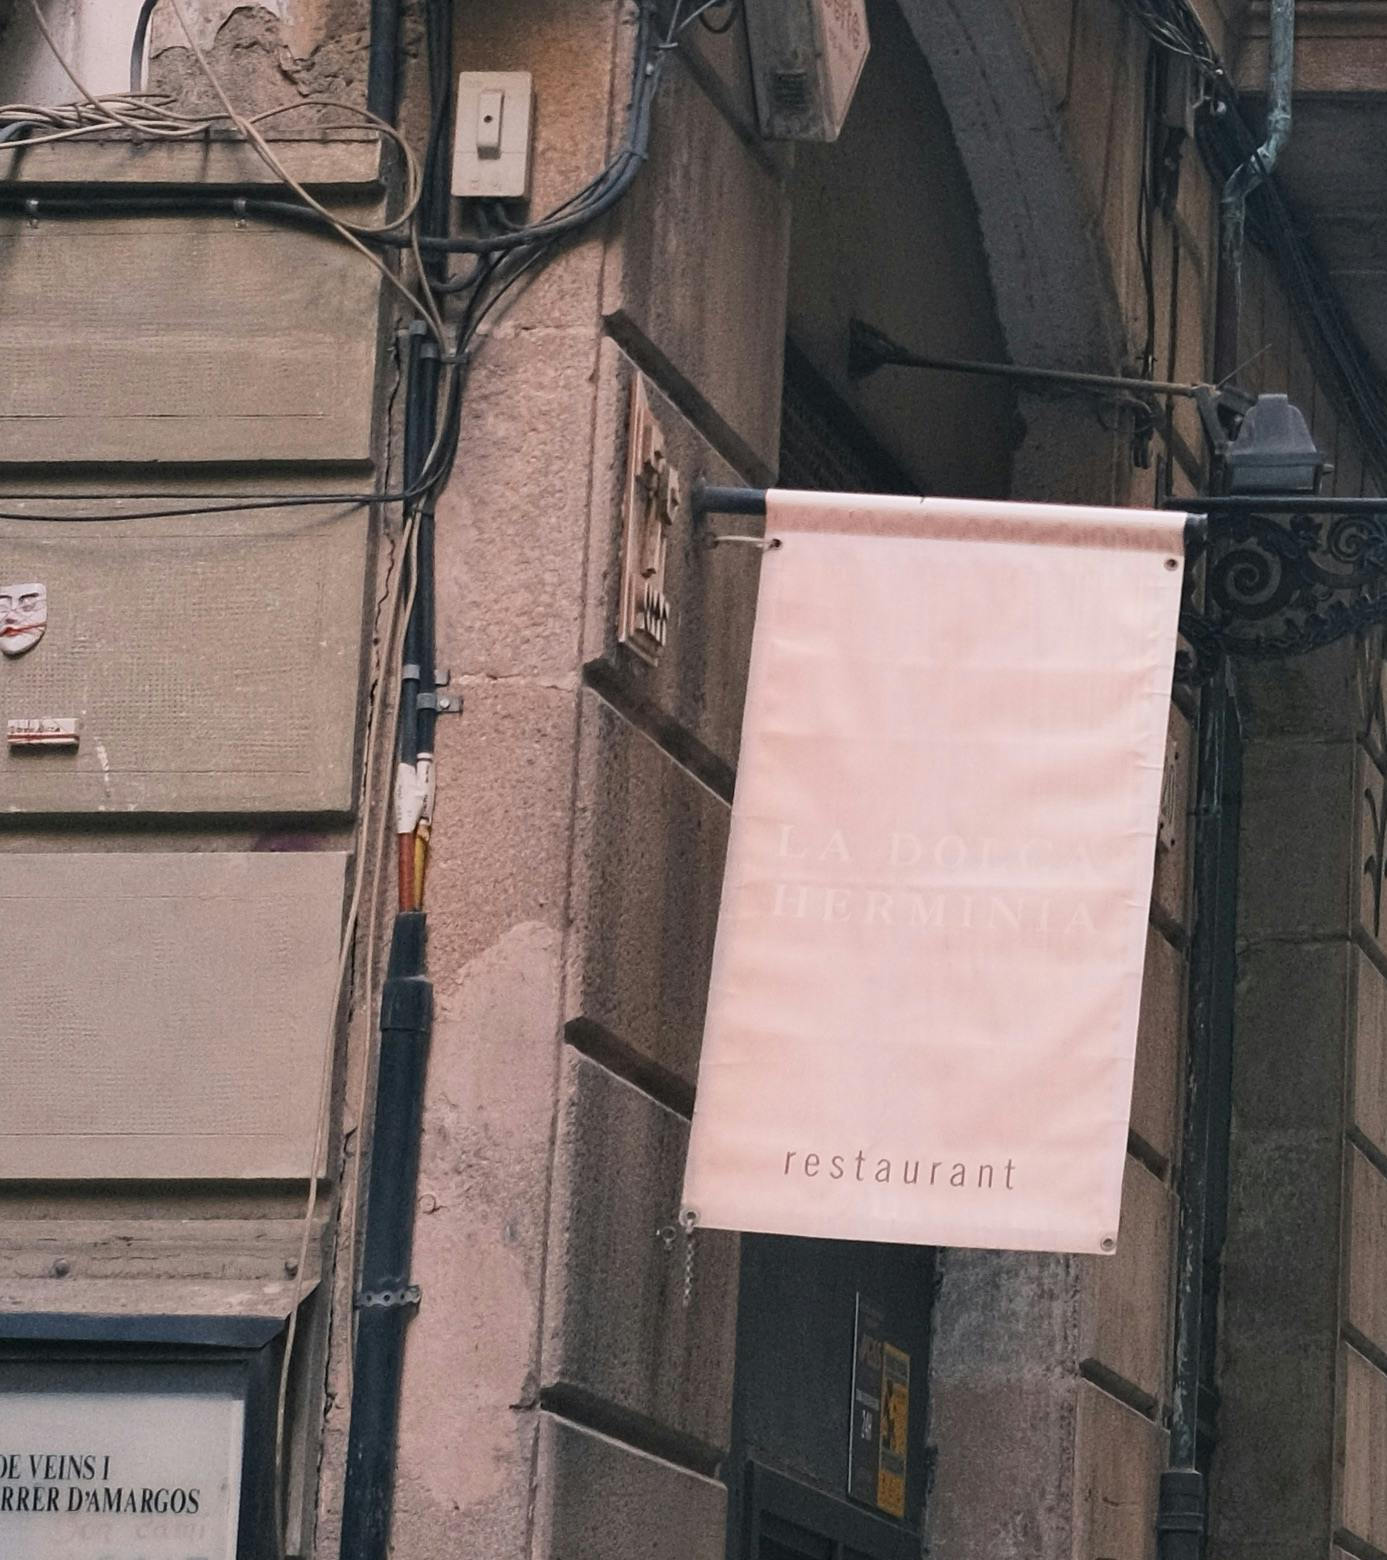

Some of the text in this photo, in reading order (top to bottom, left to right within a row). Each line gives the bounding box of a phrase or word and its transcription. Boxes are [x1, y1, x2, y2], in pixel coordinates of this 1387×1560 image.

[775, 823, 854, 864] LA
[772, 882, 1100, 936] HERMINIA
[783, 1145, 1018, 1191] restaurant
[29, 1454, 96, 1481] VEINS
